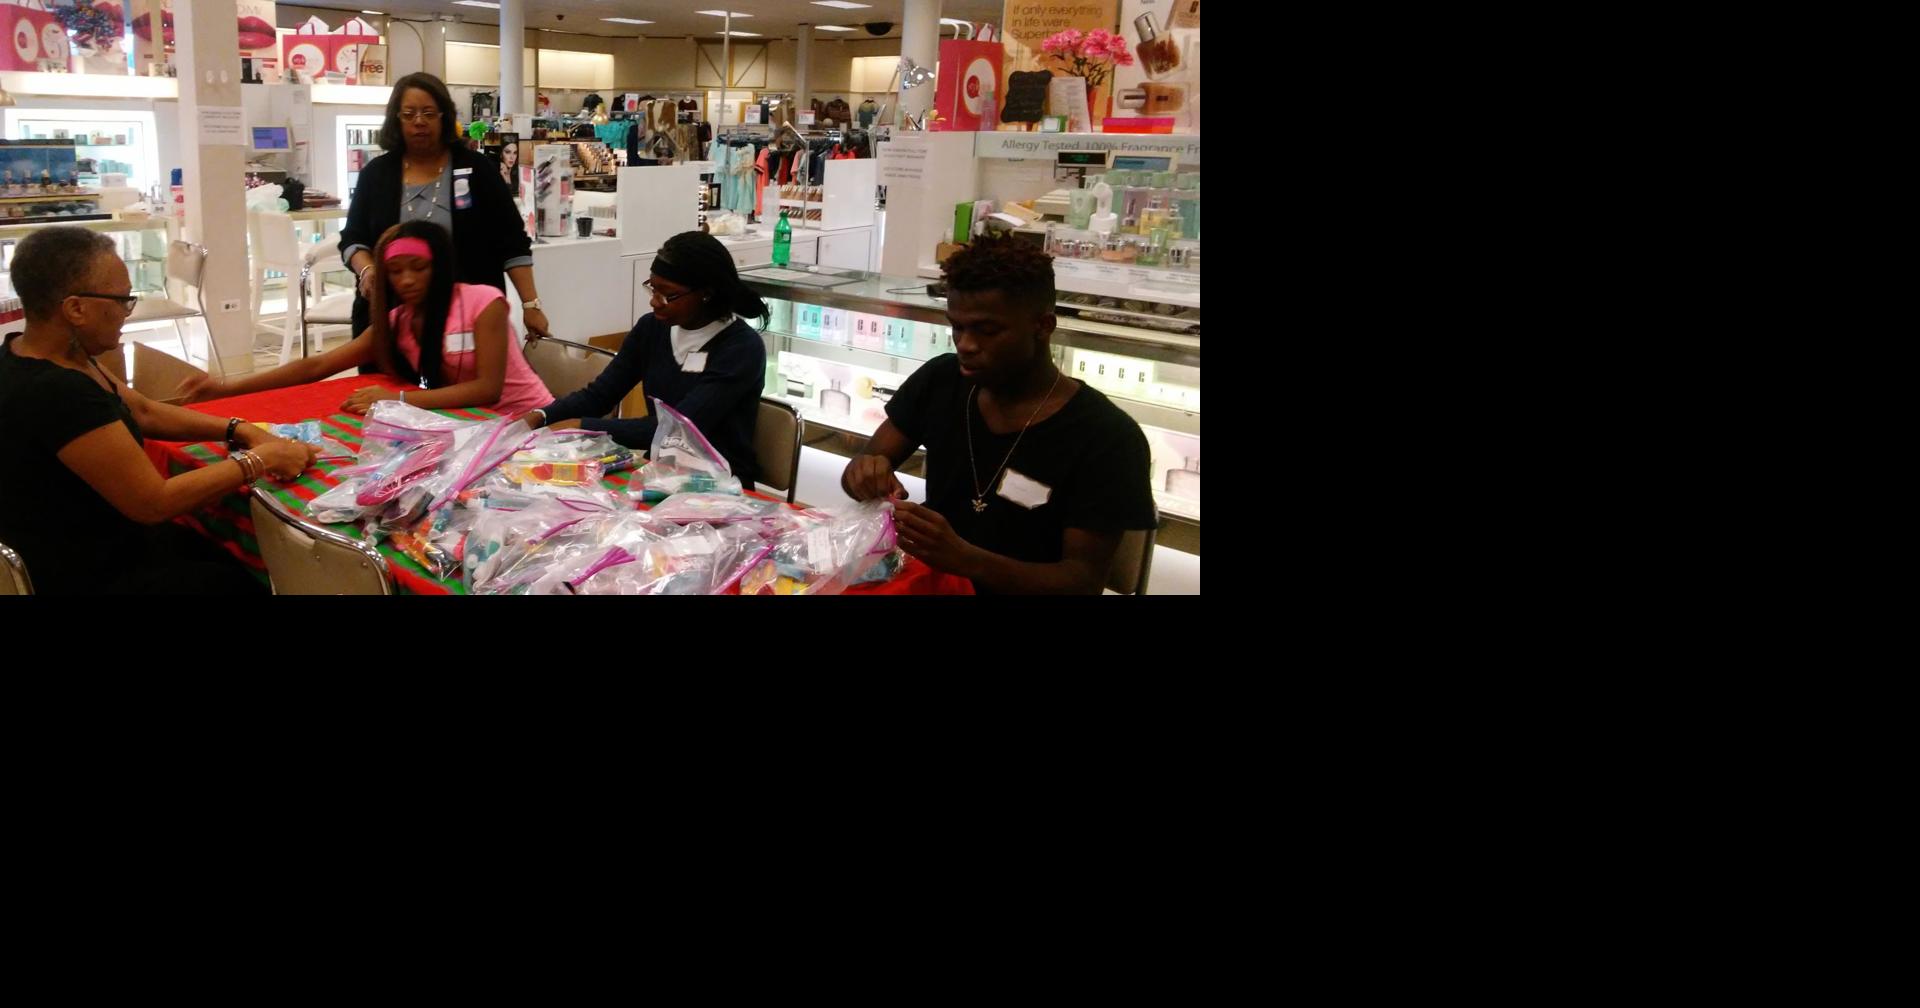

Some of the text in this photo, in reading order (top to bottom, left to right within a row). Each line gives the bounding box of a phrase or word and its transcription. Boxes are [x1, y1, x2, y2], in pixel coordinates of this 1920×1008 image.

[1022, 4, 1047, 16] only
[1048, 5, 1102, 18] everything
[1024, 16, 1040, 27] life
[1042, 19, 1071, 27] were
[360, 61, 384, 73] free
[1001, 139, 1040, 152] Allergy
[1085, 142, 1118, 150] 100%
[1121, 142, 1184, 152] Fragrance
